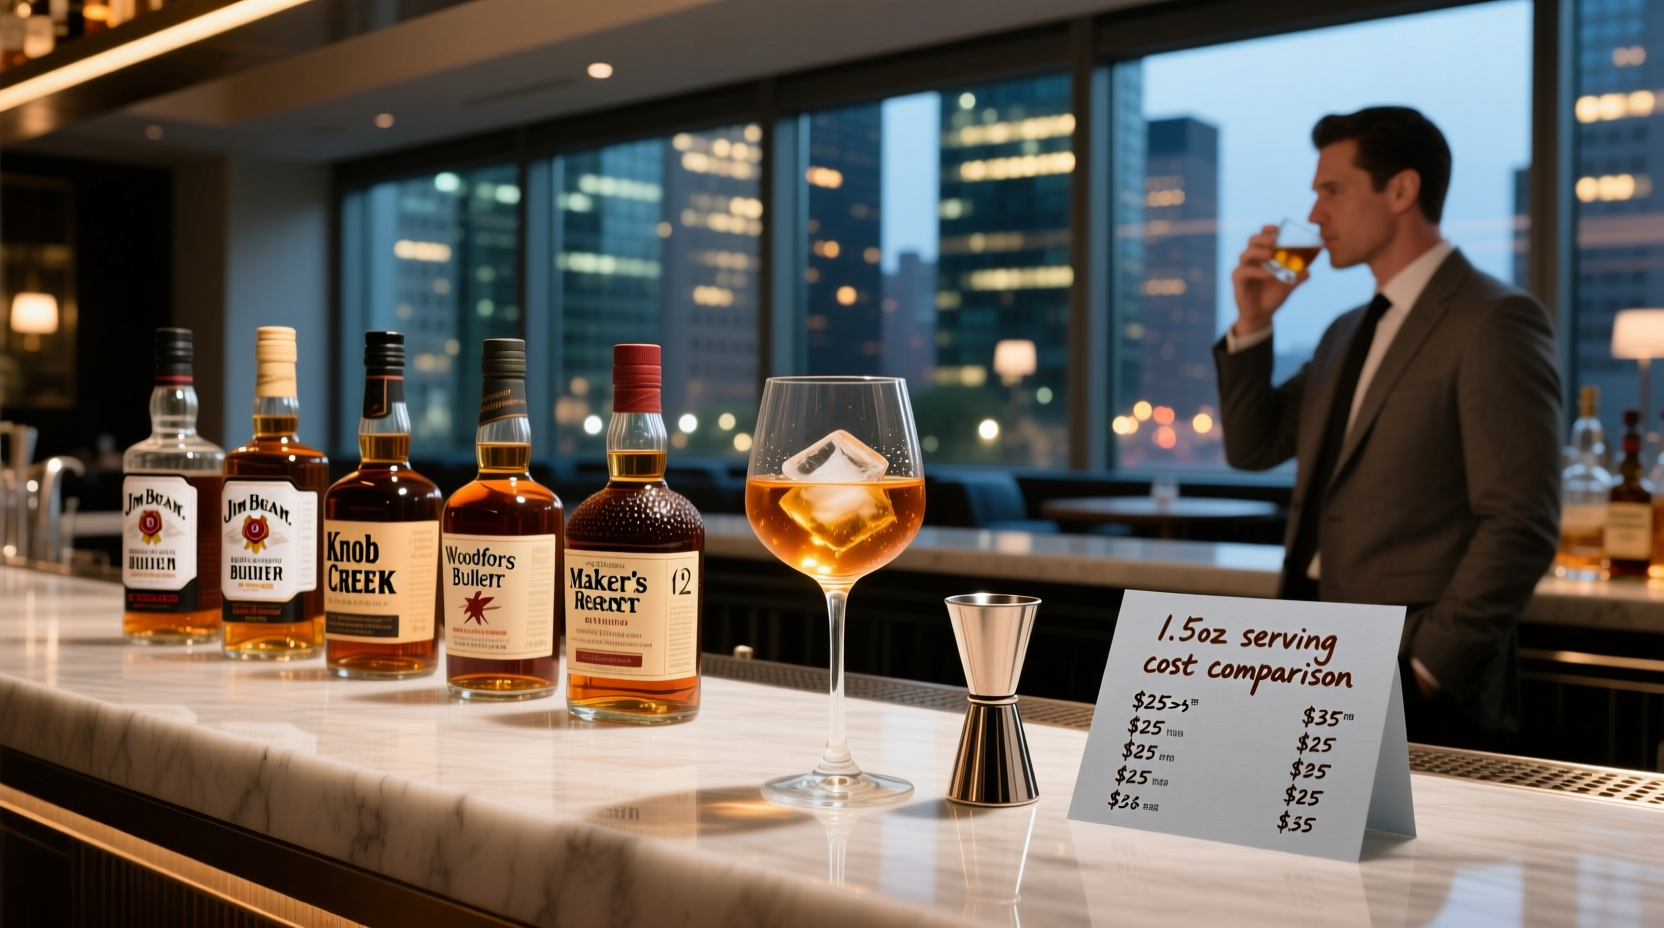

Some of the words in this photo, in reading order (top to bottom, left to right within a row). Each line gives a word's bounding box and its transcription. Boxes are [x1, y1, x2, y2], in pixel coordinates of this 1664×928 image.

[327, 532, 379, 564] Knob
[445, 545, 516, 570] Woodfors
[570, 567, 647, 594] Maker's
[1158, 614, 1227, 645] 1.5oz
[1240, 628, 1338, 666] serving
[1143, 653, 1198, 676] cost
[1207, 662, 1353, 696] comparison
[1127, 716, 1165, 737] $25
[1302, 705, 1343, 728] $35
[1122, 738, 1158, 761] $25
[1297, 731, 1336, 755] $25
[1115, 765, 1152, 786] $25
[1283, 783, 1324, 806] $25
